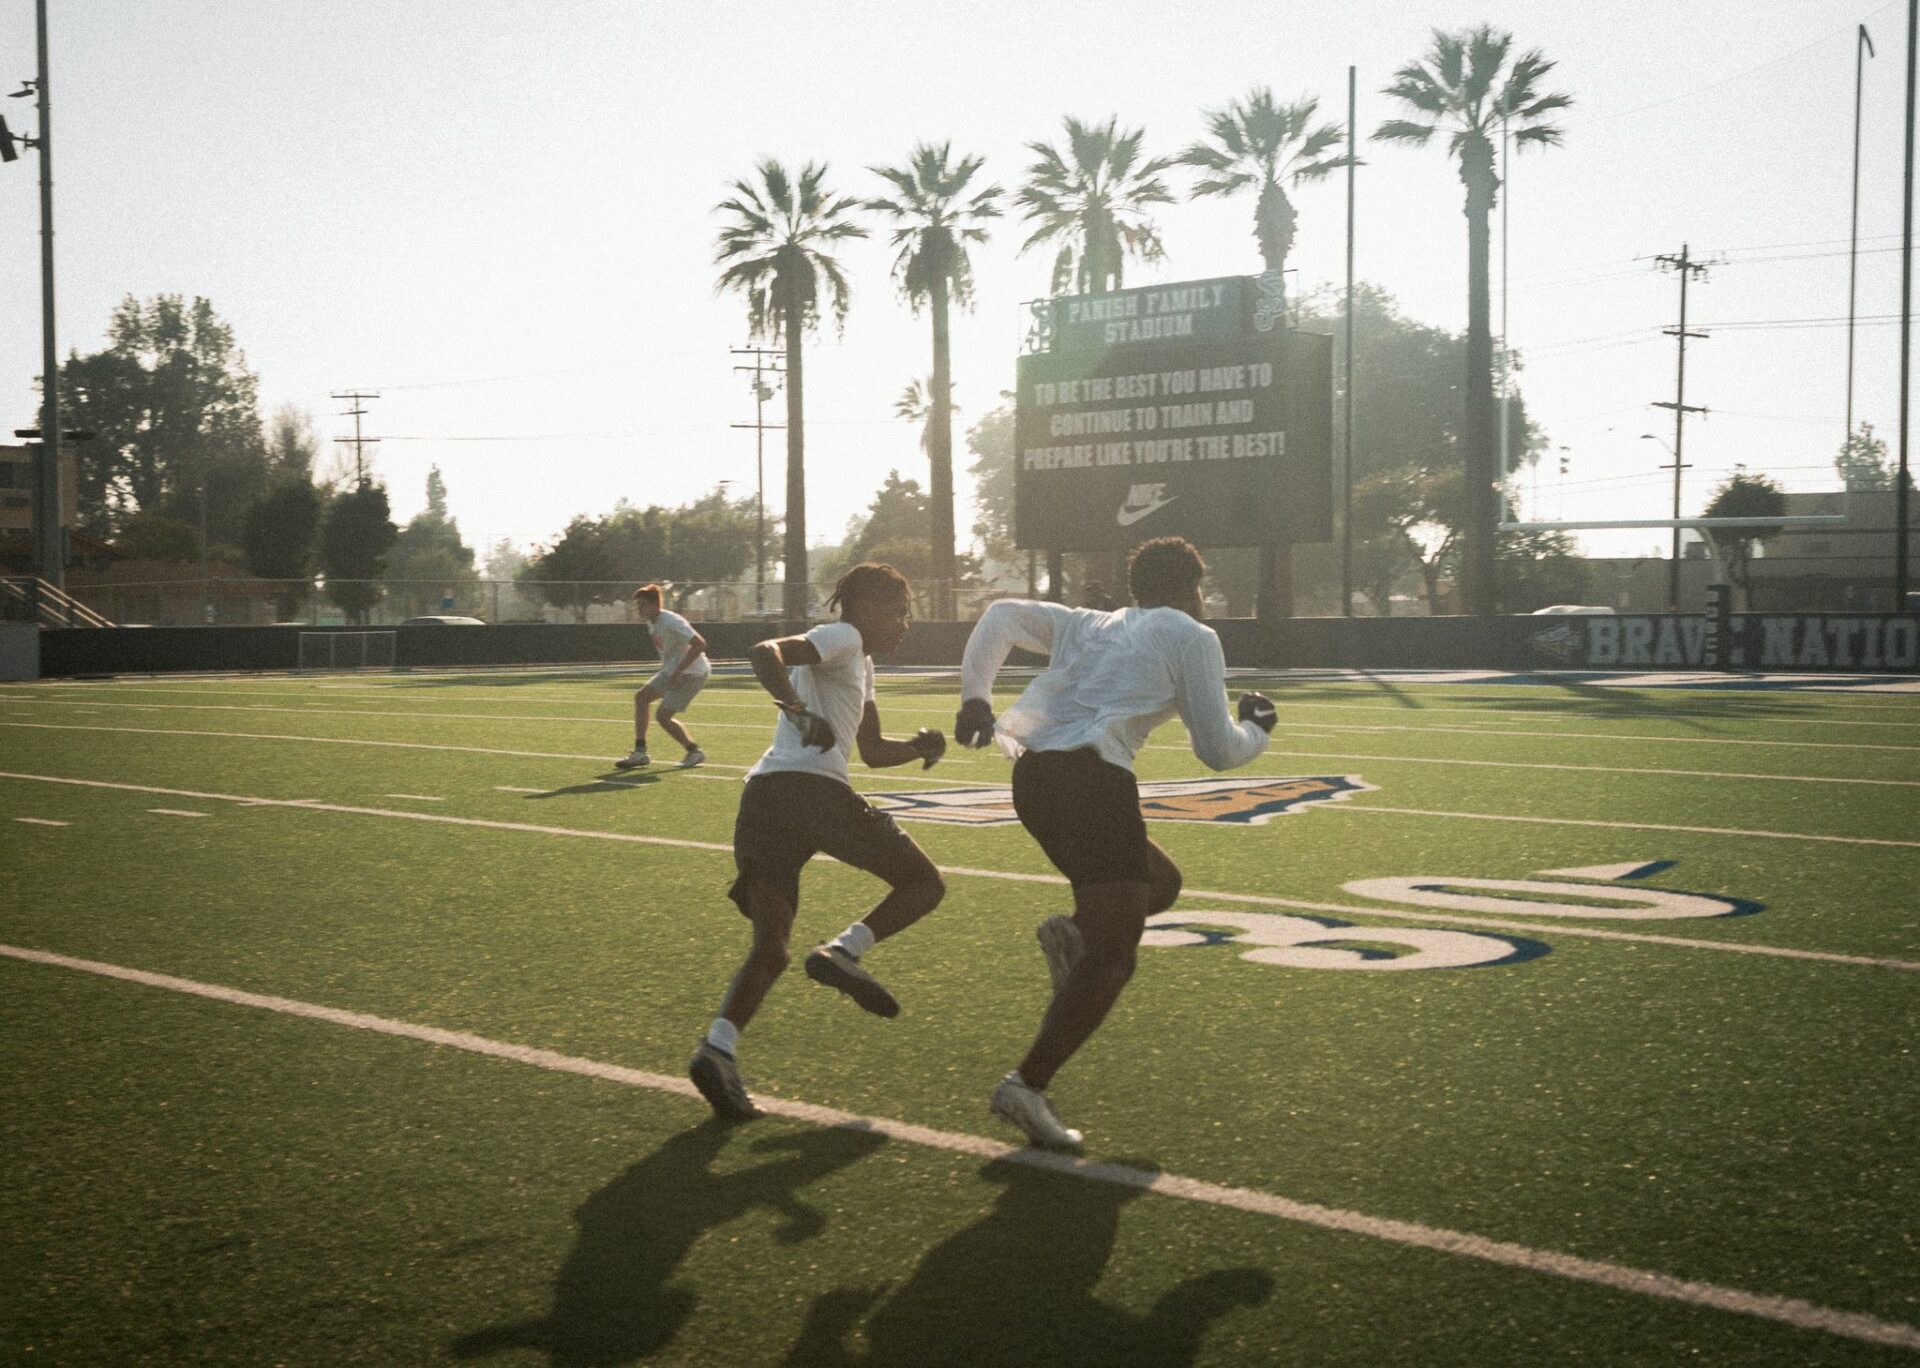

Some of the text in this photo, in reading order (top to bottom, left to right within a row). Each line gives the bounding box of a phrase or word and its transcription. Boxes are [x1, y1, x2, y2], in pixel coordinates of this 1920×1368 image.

[1146, 285, 1225, 314] FAMILY
[1104, 314, 1193, 343] STADIUM
[1034, 362, 1273, 405] TO BE THE BEST YOU HAVE TO
[1051, 399, 1254, 437] CONTINUE TO TRAIN AND
[1023, 431, 1286, 471] PREPARE LIKE YOU'RE THE BEST!
